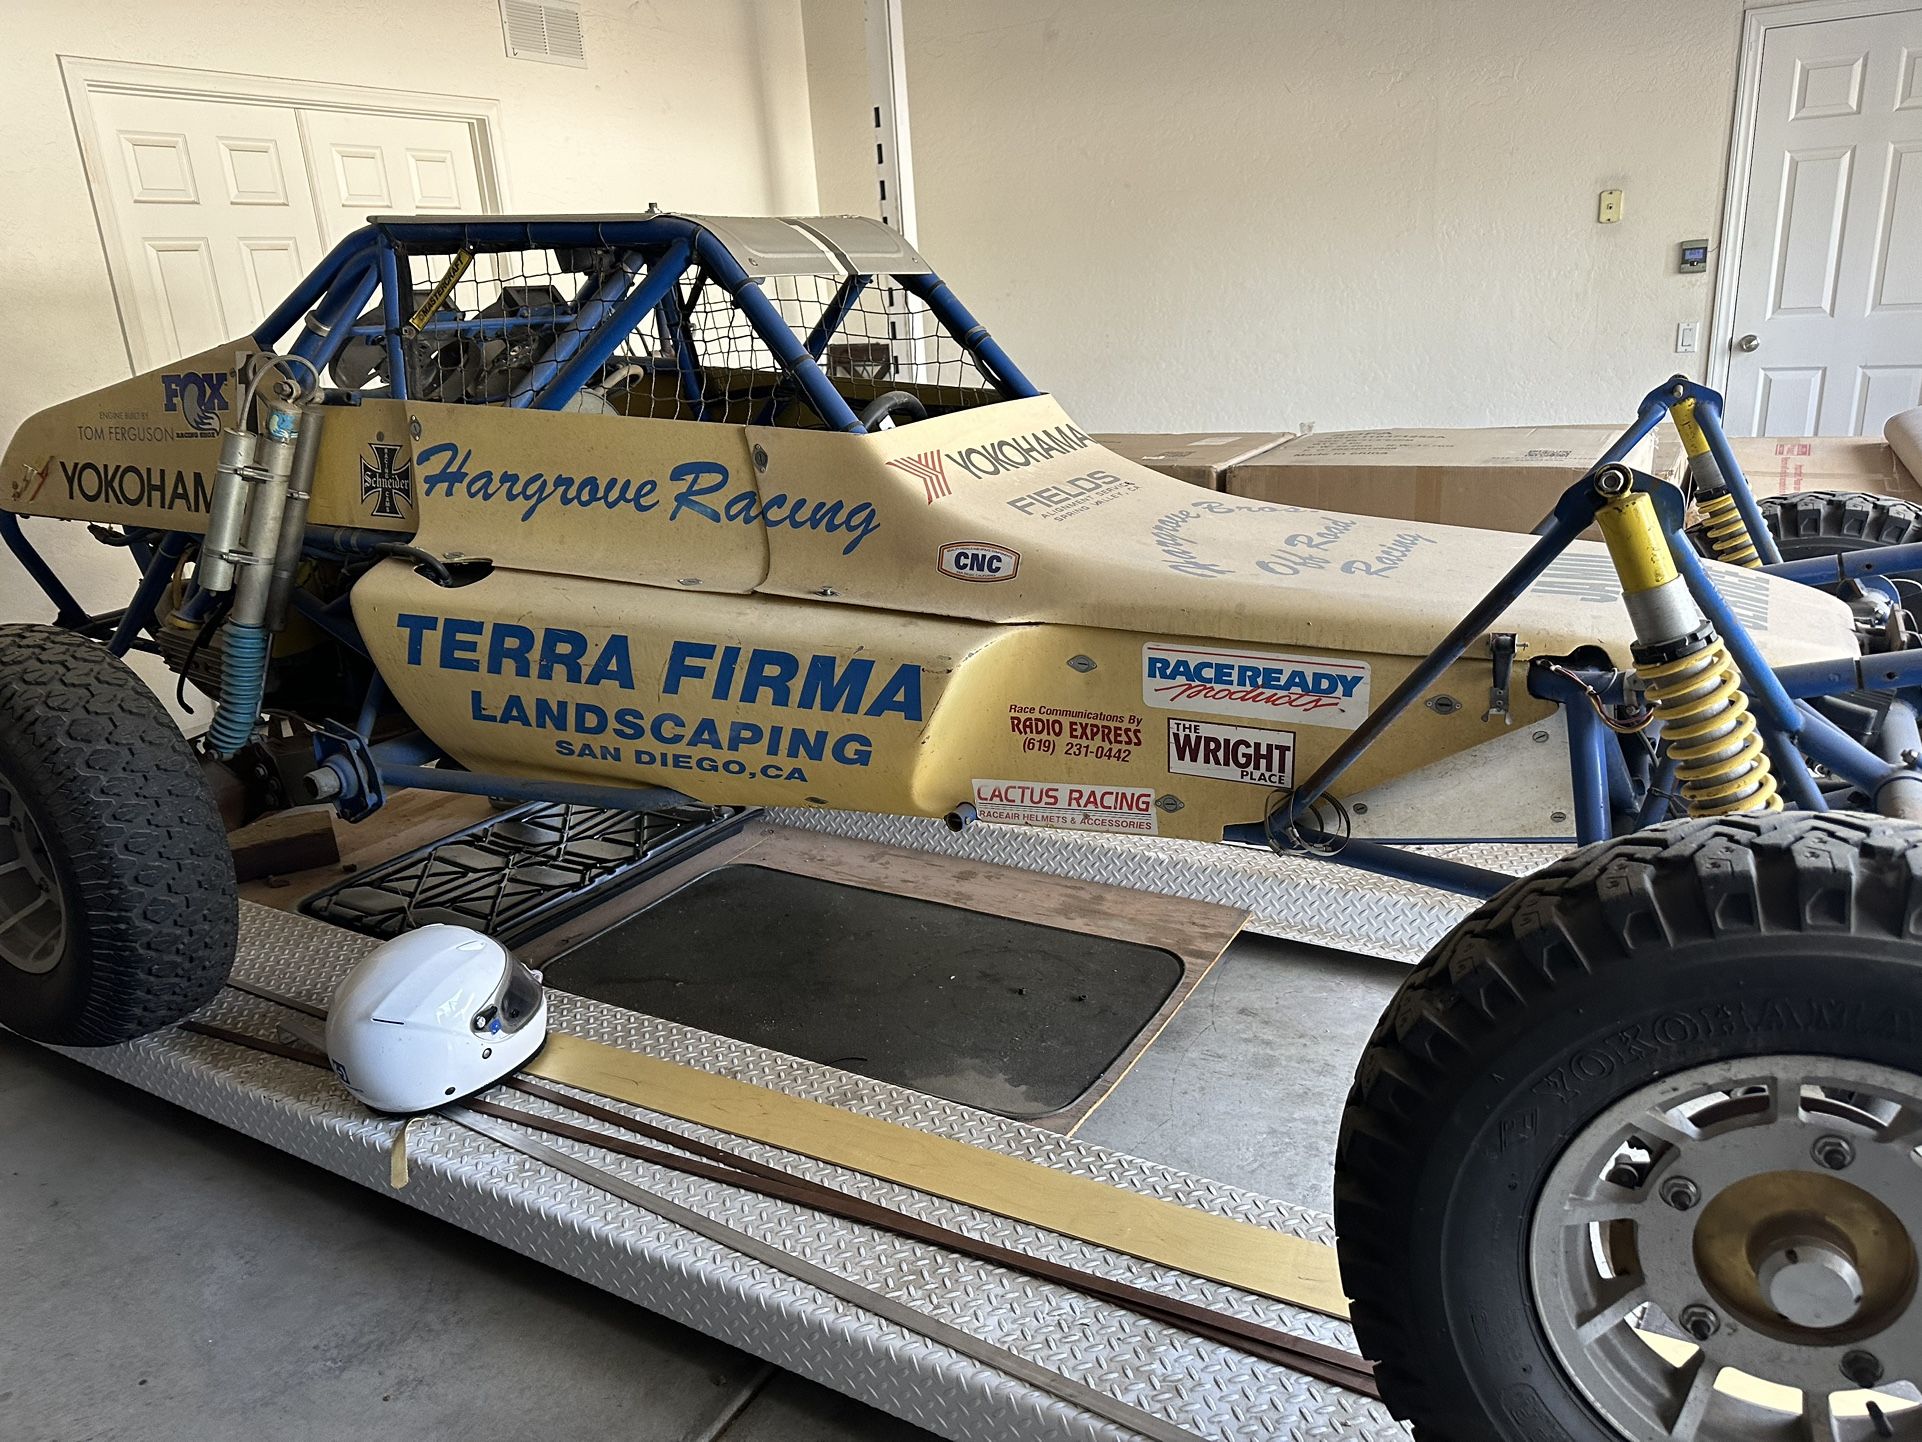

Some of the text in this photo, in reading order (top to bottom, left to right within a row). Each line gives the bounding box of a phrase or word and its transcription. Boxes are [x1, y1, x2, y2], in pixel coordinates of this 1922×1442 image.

[422, 254, 464, 316] MASTERCRAFT
[161, 371, 229, 412] FOX
[78, 425, 174, 442] TOM FERGUSON
[945, 423, 1099, 480] YOKOHAMA
[59, 460, 217, 514] YOKOHAM
[364, 471, 409, 490] Schneider
[1007, 470, 1121, 516] FIELDS
[416, 442, 881, 556] Hargrove Racing
[1041, 494, 1094, 519] ALIGNMENT
[1054, 504, 1091, 522] SPRING
[1256, 516, 1357, 576] Off Road
[1340, 532, 1438, 579] Racing
[954, 551, 1002, 574] CNC
[396, 613, 923, 722] TERRA FIRMA
[1154, 683, 1342, 712] products
[471, 690, 873, 767] LANDSCAPING
[1009, 704, 1143, 727] Race Communications By
[1174, 722, 1200, 734] THE
[1010, 716, 1142, 747] RADIO EXPRESS
[555, 739, 622, 762] SAN
[1023, 737, 1131, 763] (619) 231-0442
[1172, 732, 1291, 774] WRIGHT
[1240, 769, 1285, 785] PLACE
[976, 785, 1152, 813] CACTUS RACING
[979, 810, 1020, 821] RACEAIR
[1022, 813, 1067, 824] HELMETS
[1080, 817, 1152, 830] ACCESSORIES
[1531, 999, 1915, 1103] YOKOHAM
